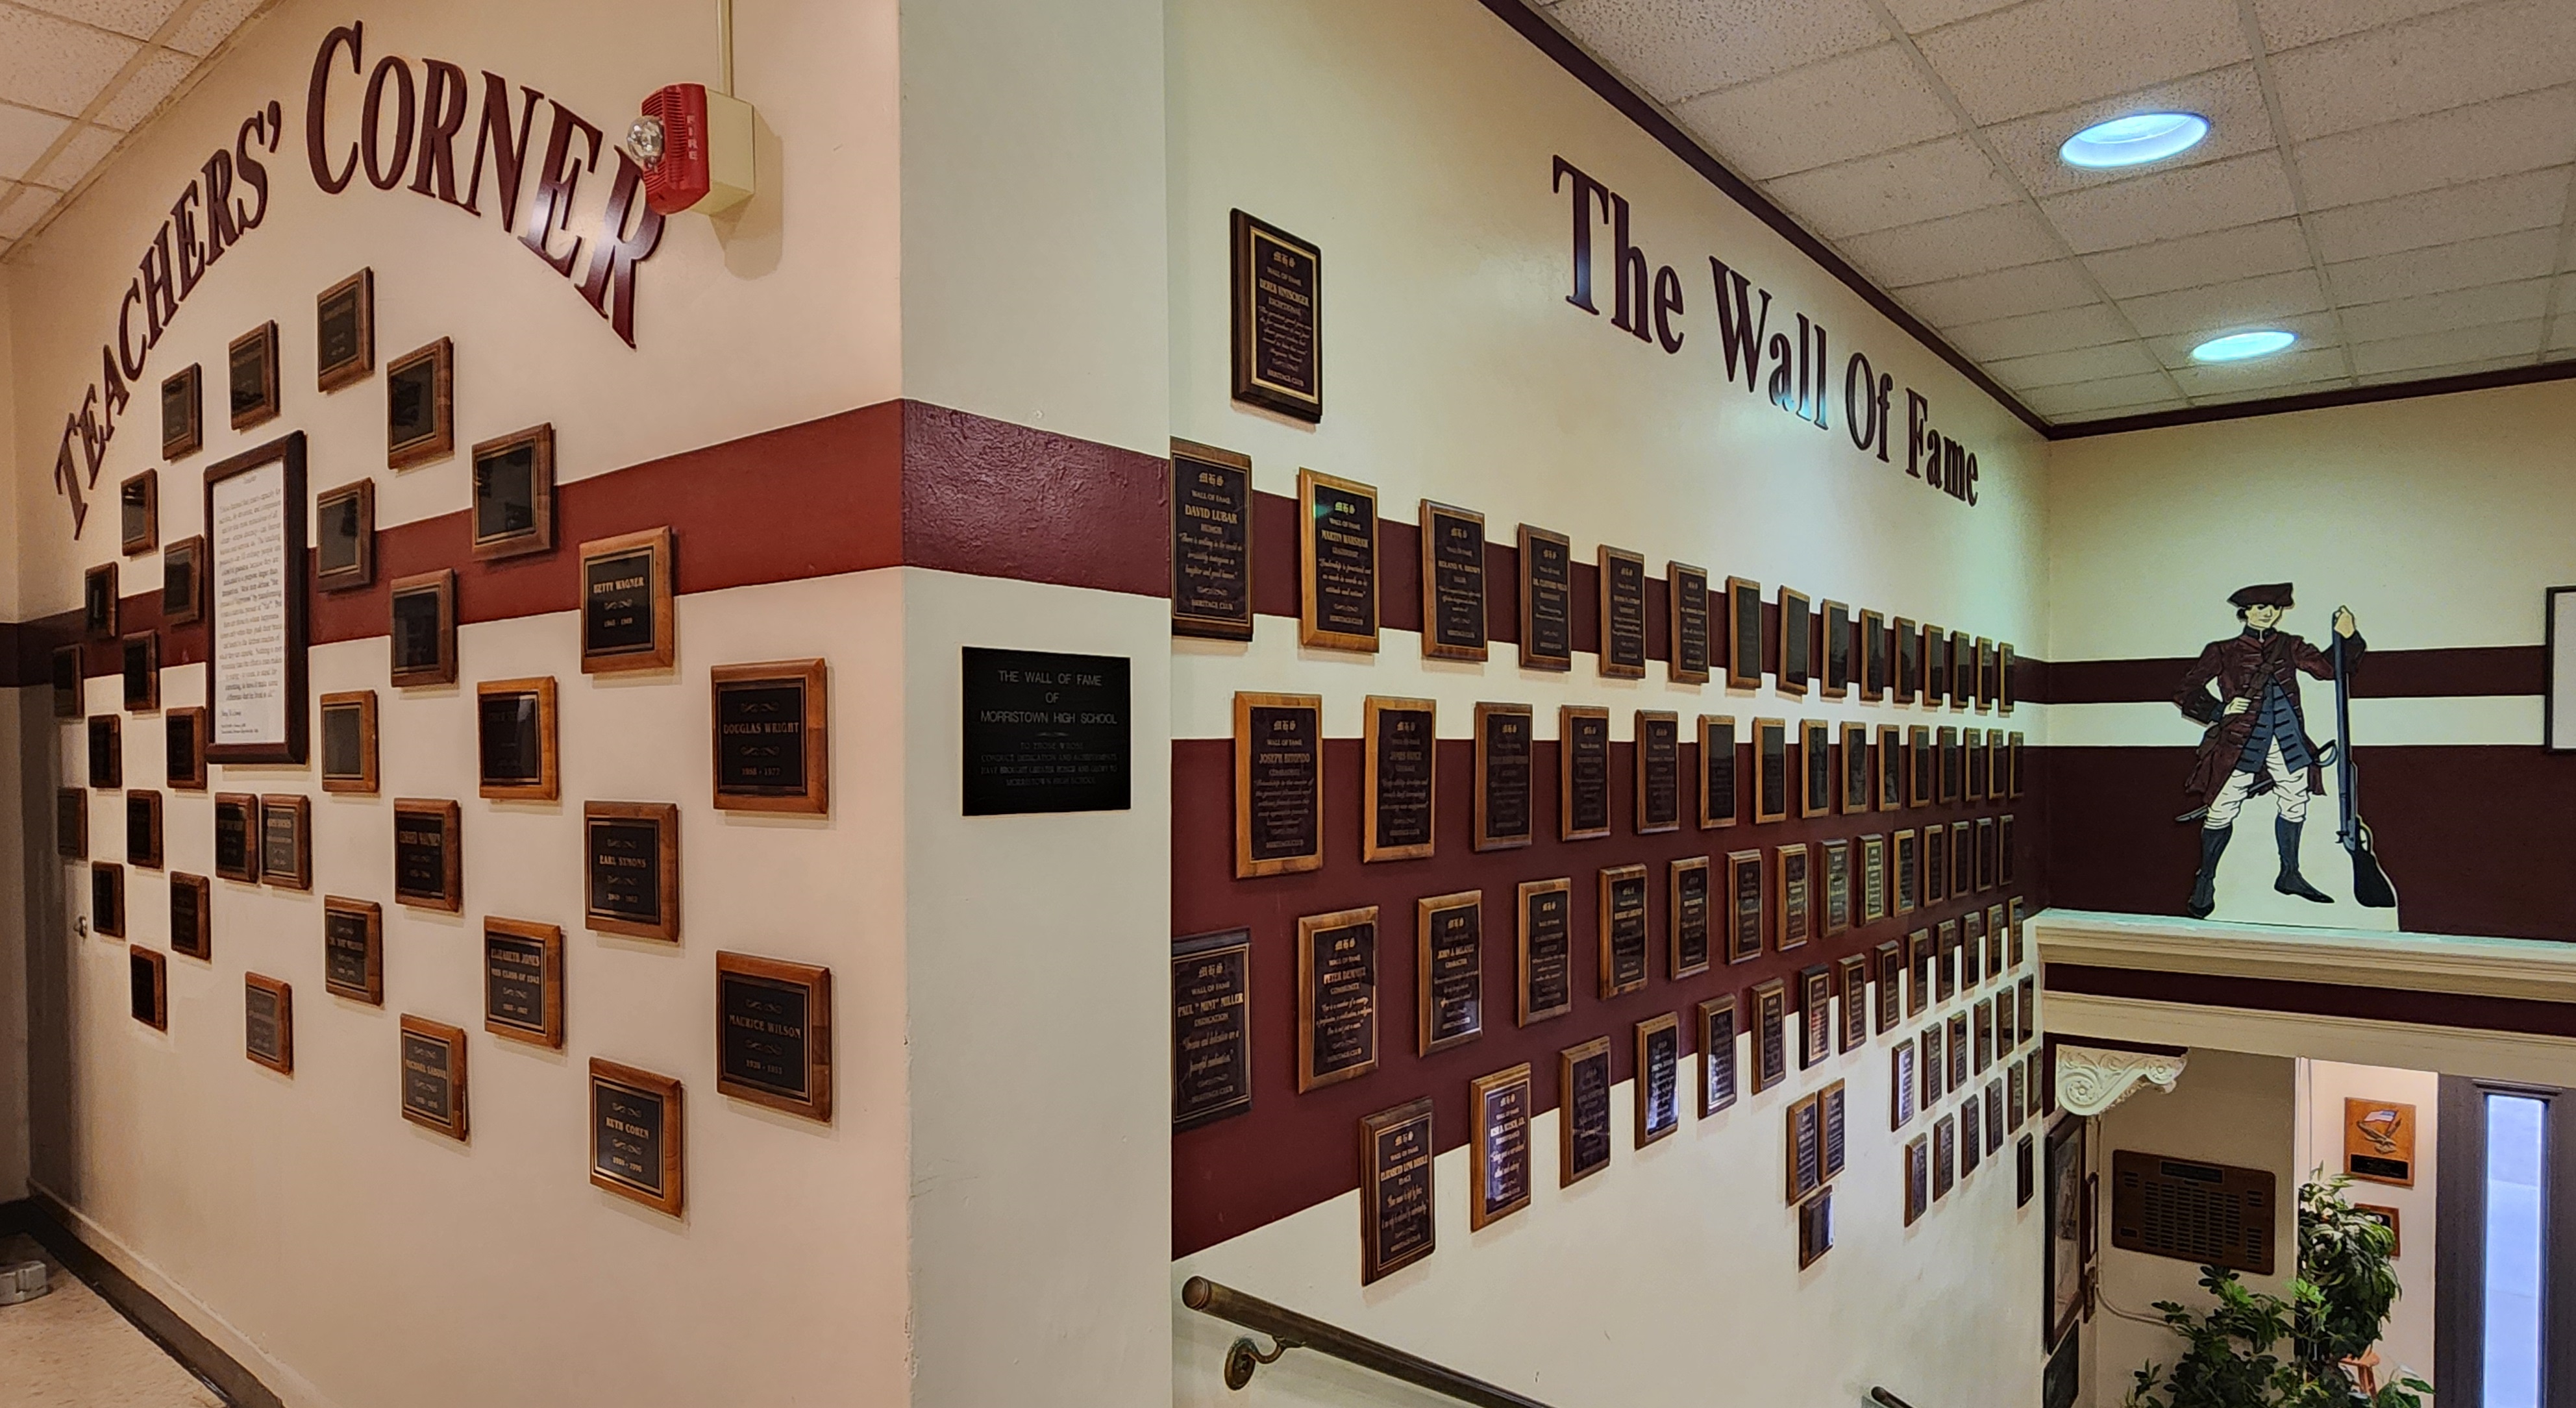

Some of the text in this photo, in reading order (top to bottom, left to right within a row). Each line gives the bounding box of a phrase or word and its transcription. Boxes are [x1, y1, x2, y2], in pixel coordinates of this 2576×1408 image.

[686, 115, 698, 160] FIRE
[306, 19, 666, 350] CORNER
[1553, 154, 1979, 506] The Wall Of Fame
[1199, 473, 1224, 487] MHS
[1192, 489, 1207, 499] WALL
[1216, 495, 1231, 504] FAME
[1185, 504, 1238, 525] DAVID LUBAR
[1329, 517, 1341, 526] WALL
[593, 576, 644, 593] BETTY WAGNER
[1191, 599, 1233, 611] HERITAGE CLUB
[998, 669, 1102, 687] THE WALL OF FAME
[1045, 691, 1059, 704] OF
[980, 710, 1117, 725] MORRISTOWN HIGH SCHOOL
[723, 722, 799, 734] DOUGLAS WRIGHT
[1259, 752, 1283, 764] JOSEPH
[599, 854, 616, 866] EARL
[502, 969, 518, 980] CLASS
[519, 973, 526, 982] OF
[1323, 971, 1342, 985] PETER
[1191, 982, 1230, 996] WALL OF FAME
[1178, 1004, 1194, 1019] PAUL
[1220, 992, 1244, 1009] MILLER
[729, 1014, 801, 1039] MAURICE WILSON
[1194, 1012, 1228, 1027] DEDICATION
[625, 1122, 649, 1140] COHEN
